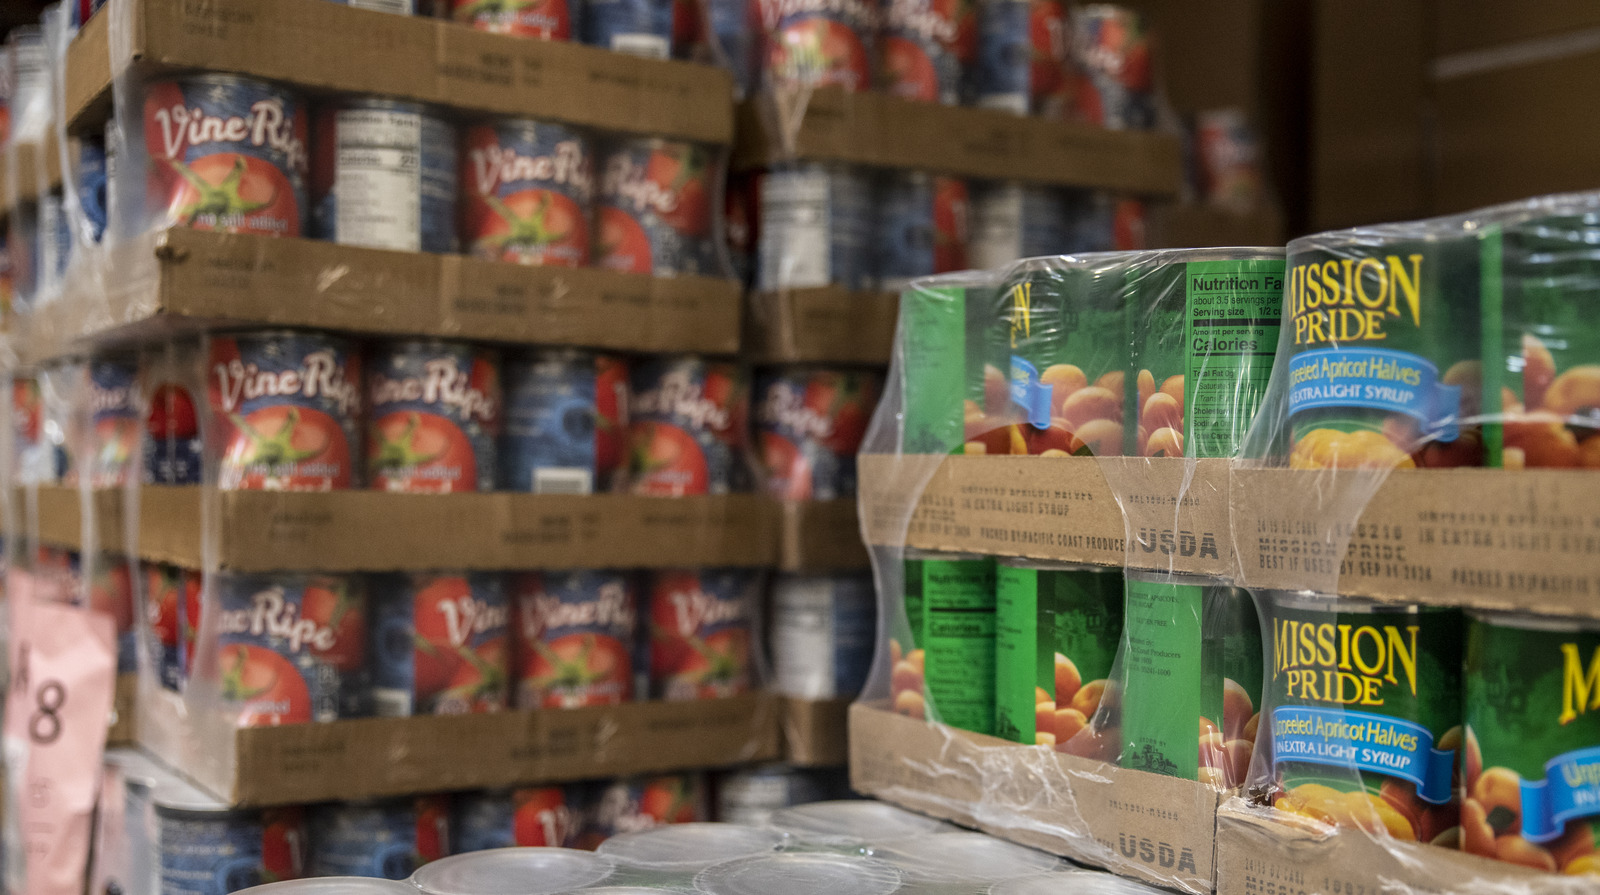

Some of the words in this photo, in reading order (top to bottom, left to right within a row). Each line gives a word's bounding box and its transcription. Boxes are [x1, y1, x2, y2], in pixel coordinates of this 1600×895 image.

[155, 104, 249, 159] Vine
[251, 98, 308, 172] Rip
[1193, 277, 1259, 291] Nutrition
[1193, 297, 1215, 305] about
[1217, 296, 1229, 305] 3.5
[1231, 296, 1265, 306] servings
[1267, 297, 1279, 305] per
[1193, 308, 1225, 317] Serving
[1227, 307, 1244, 316] size
[1259, 307, 1271, 316] 1/2
[1295, 307, 1387, 344] PRIDE
[1193, 337, 1258, 351] Calories
[214, 358, 300, 412] Vine
[302, 349, 360, 416] Rip
[423, 354, 497, 420] Ripe
[1321, 356, 1368, 383] Apricot
[1369, 356, 1422, 386] Halves
[1295, 386, 1322, 403] EXTRA
[1323, 384, 1362, 398] LIGHT
[1365, 384, 1414, 404] SYRUP
[1057, 534, 1083, 548] COAST
[1086, 536, 1136, 553] PRODUCES
[1139, 528, 1220, 560] USDA
[1258, 538, 1337, 557] MISSION
[1348, 543, 1406, 562] PRIDE
[1259, 554, 1284, 571] BEST
[1289, 557, 1299, 572] IF
[1304, 558, 1333, 575] USED
[1340, 560, 1354, 576] BY
[1359, 561, 1381, 577] SEP
[251, 585, 337, 652] Ripe
[437, 595, 504, 647] Vin
[1150, 648, 1182, 660] Producers
[1273, 617, 1421, 698] MISSION
[1287, 669, 1385, 706] PRIDE
[29, 679, 67, 745] 8
[1315, 716, 1365, 742] Apricot
[1366, 721, 1419, 752] Halves
[1285, 741, 1316, 754] EXTRA
[1318, 744, 1359, 760] LIGHT
[1361, 748, 1411, 769] SYRUP
[1119, 833, 1197, 875] USDA
